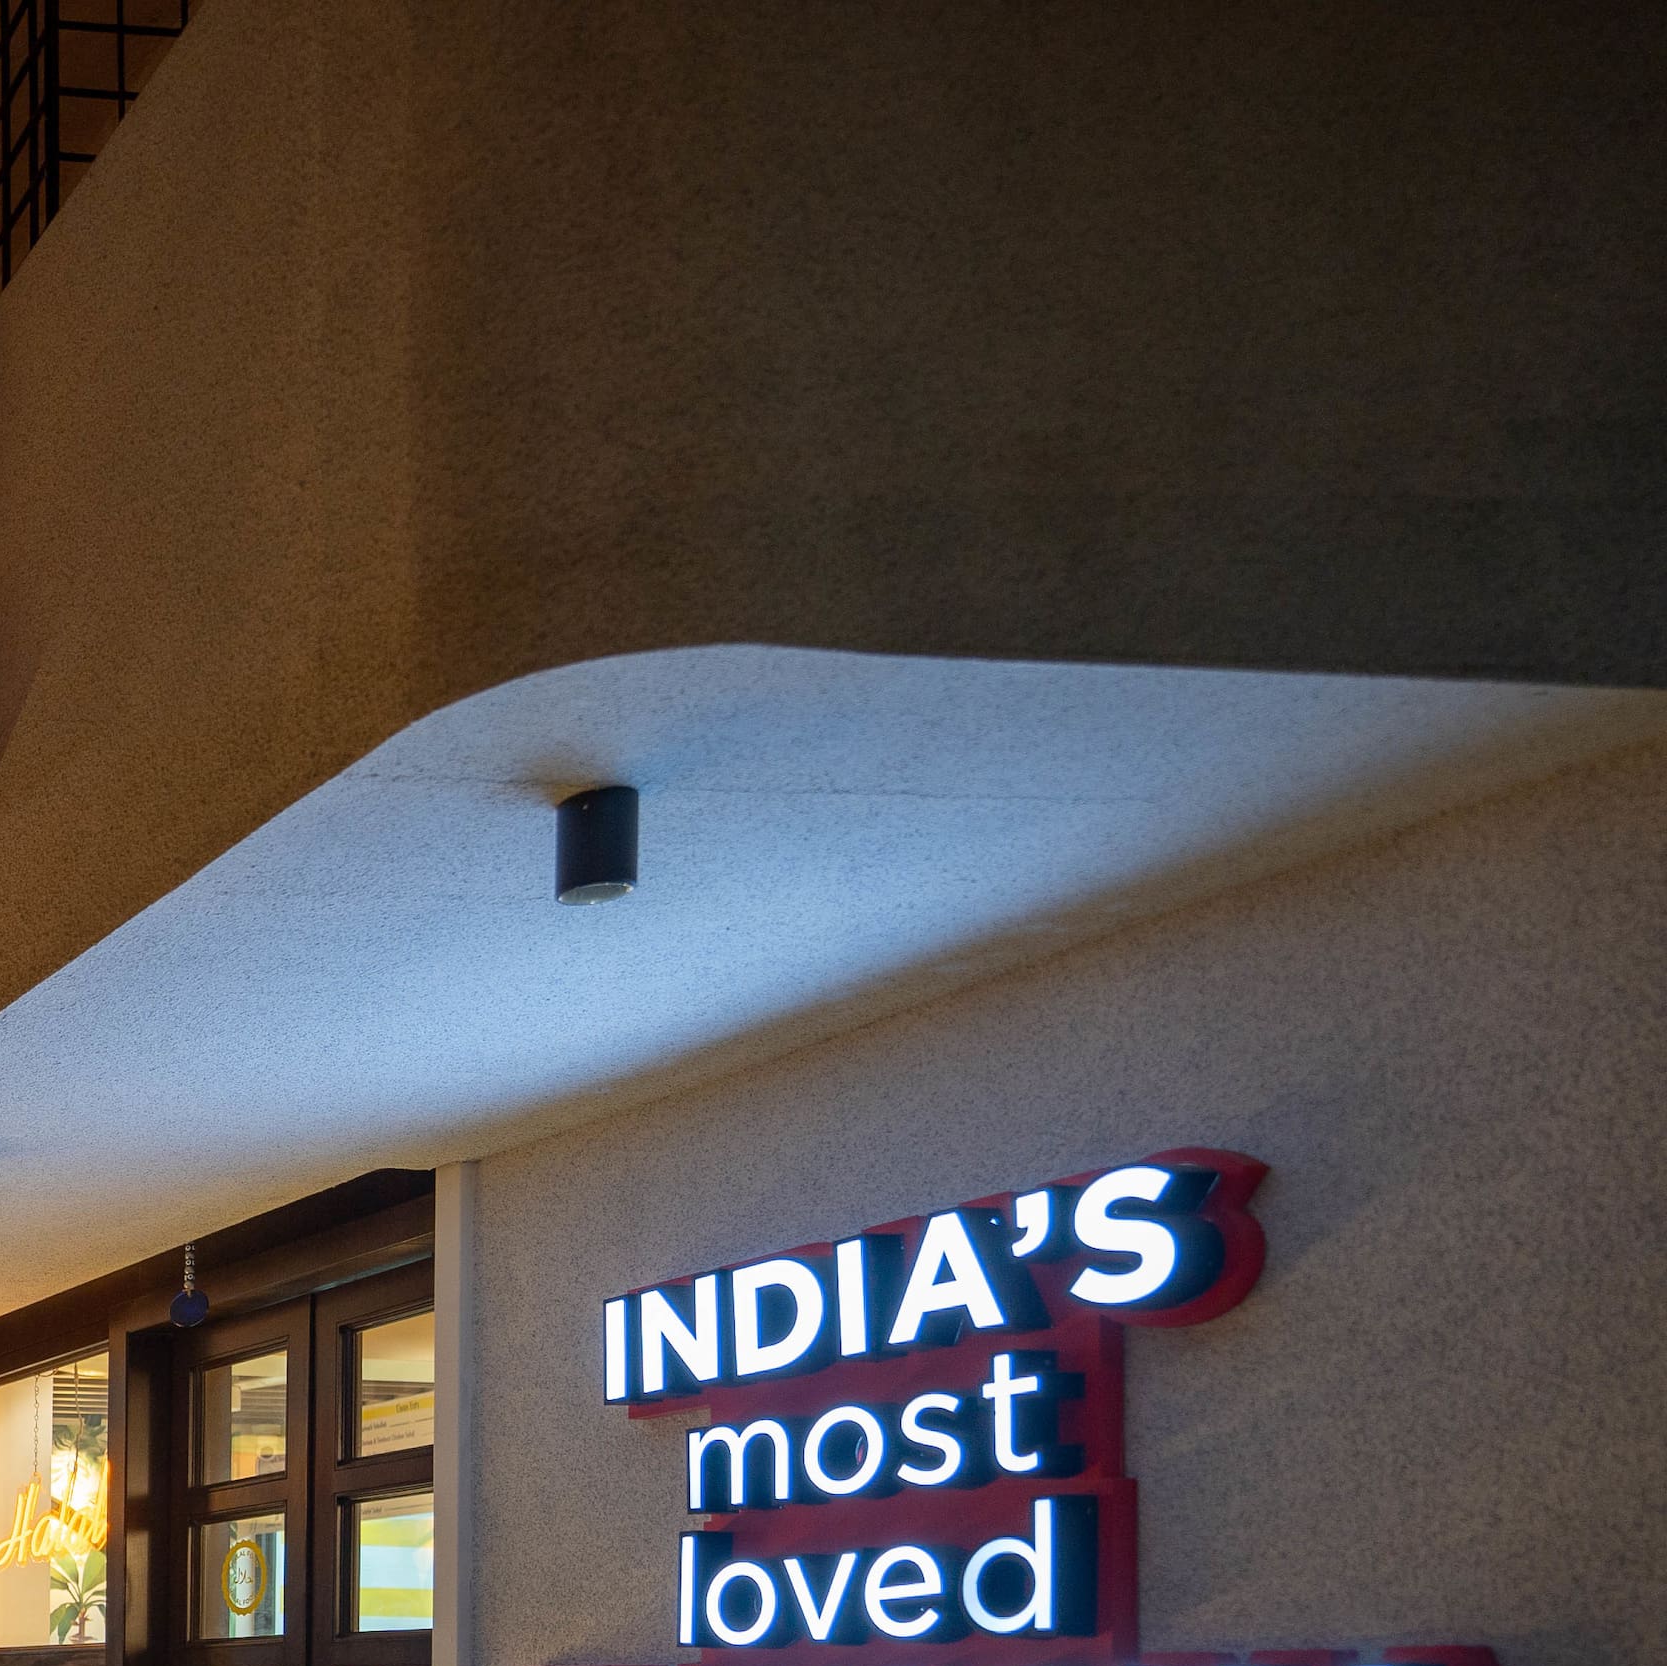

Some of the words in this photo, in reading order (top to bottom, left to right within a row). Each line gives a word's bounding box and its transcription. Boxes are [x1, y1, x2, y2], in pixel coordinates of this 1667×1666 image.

[603, 1164, 1181, 1402] INDIA'S
[688, 1354, 1039, 1510] most
[678, 1498, 1054, 1646] loved
